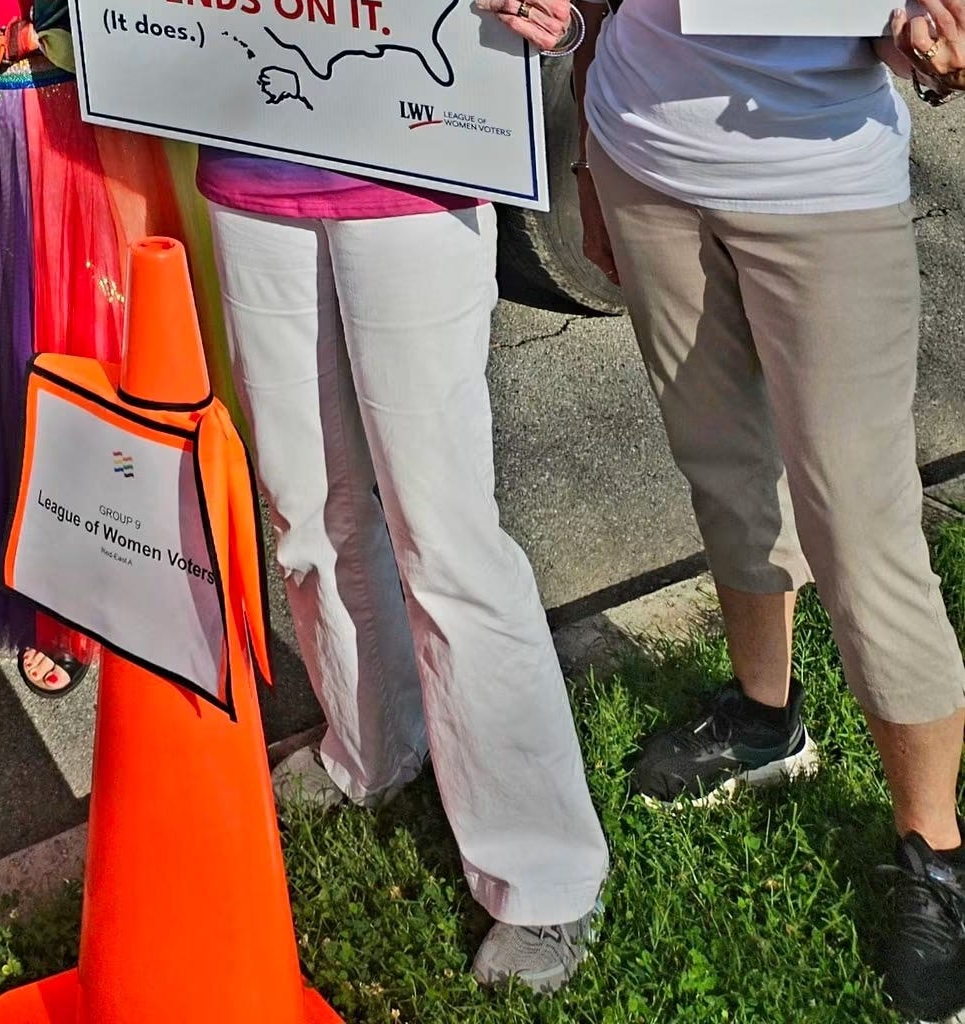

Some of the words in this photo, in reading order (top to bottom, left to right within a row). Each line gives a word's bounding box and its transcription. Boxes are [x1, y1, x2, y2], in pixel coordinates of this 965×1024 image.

[103, 8, 128, 34] (It
[135, 14, 205, 48] does.)
[399, 100, 435, 122] LWV
[443, 111, 476, 123] LEAGUE
[444, 119, 477, 130] WOMEN
[99, 504, 133, 525] GROUP
[135, 519, 141, 530] 9
[37, 489, 81, 527] League
[85, 520, 101, 536] of
[103, 523, 162, 561] Women
[167, 548, 216, 585] Voters
